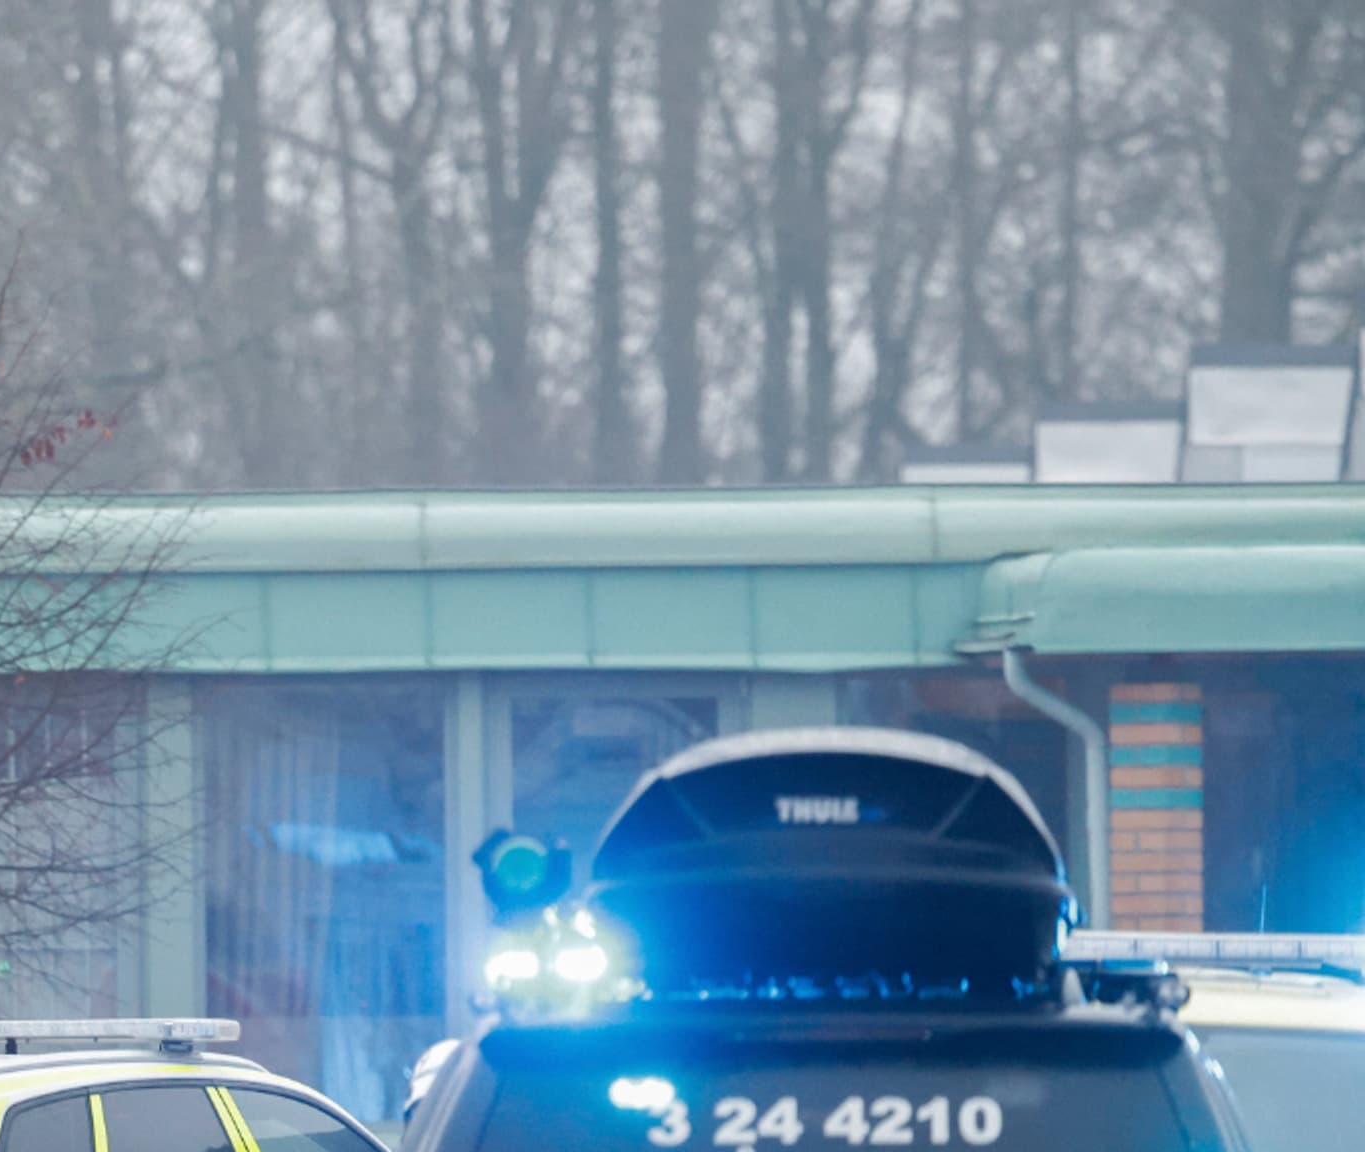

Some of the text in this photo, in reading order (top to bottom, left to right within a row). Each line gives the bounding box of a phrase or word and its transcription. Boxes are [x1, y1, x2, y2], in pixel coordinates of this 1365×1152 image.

[774, 797, 859, 823] THULE
[648, 1097, 1003, 1146] 3 24 4210
